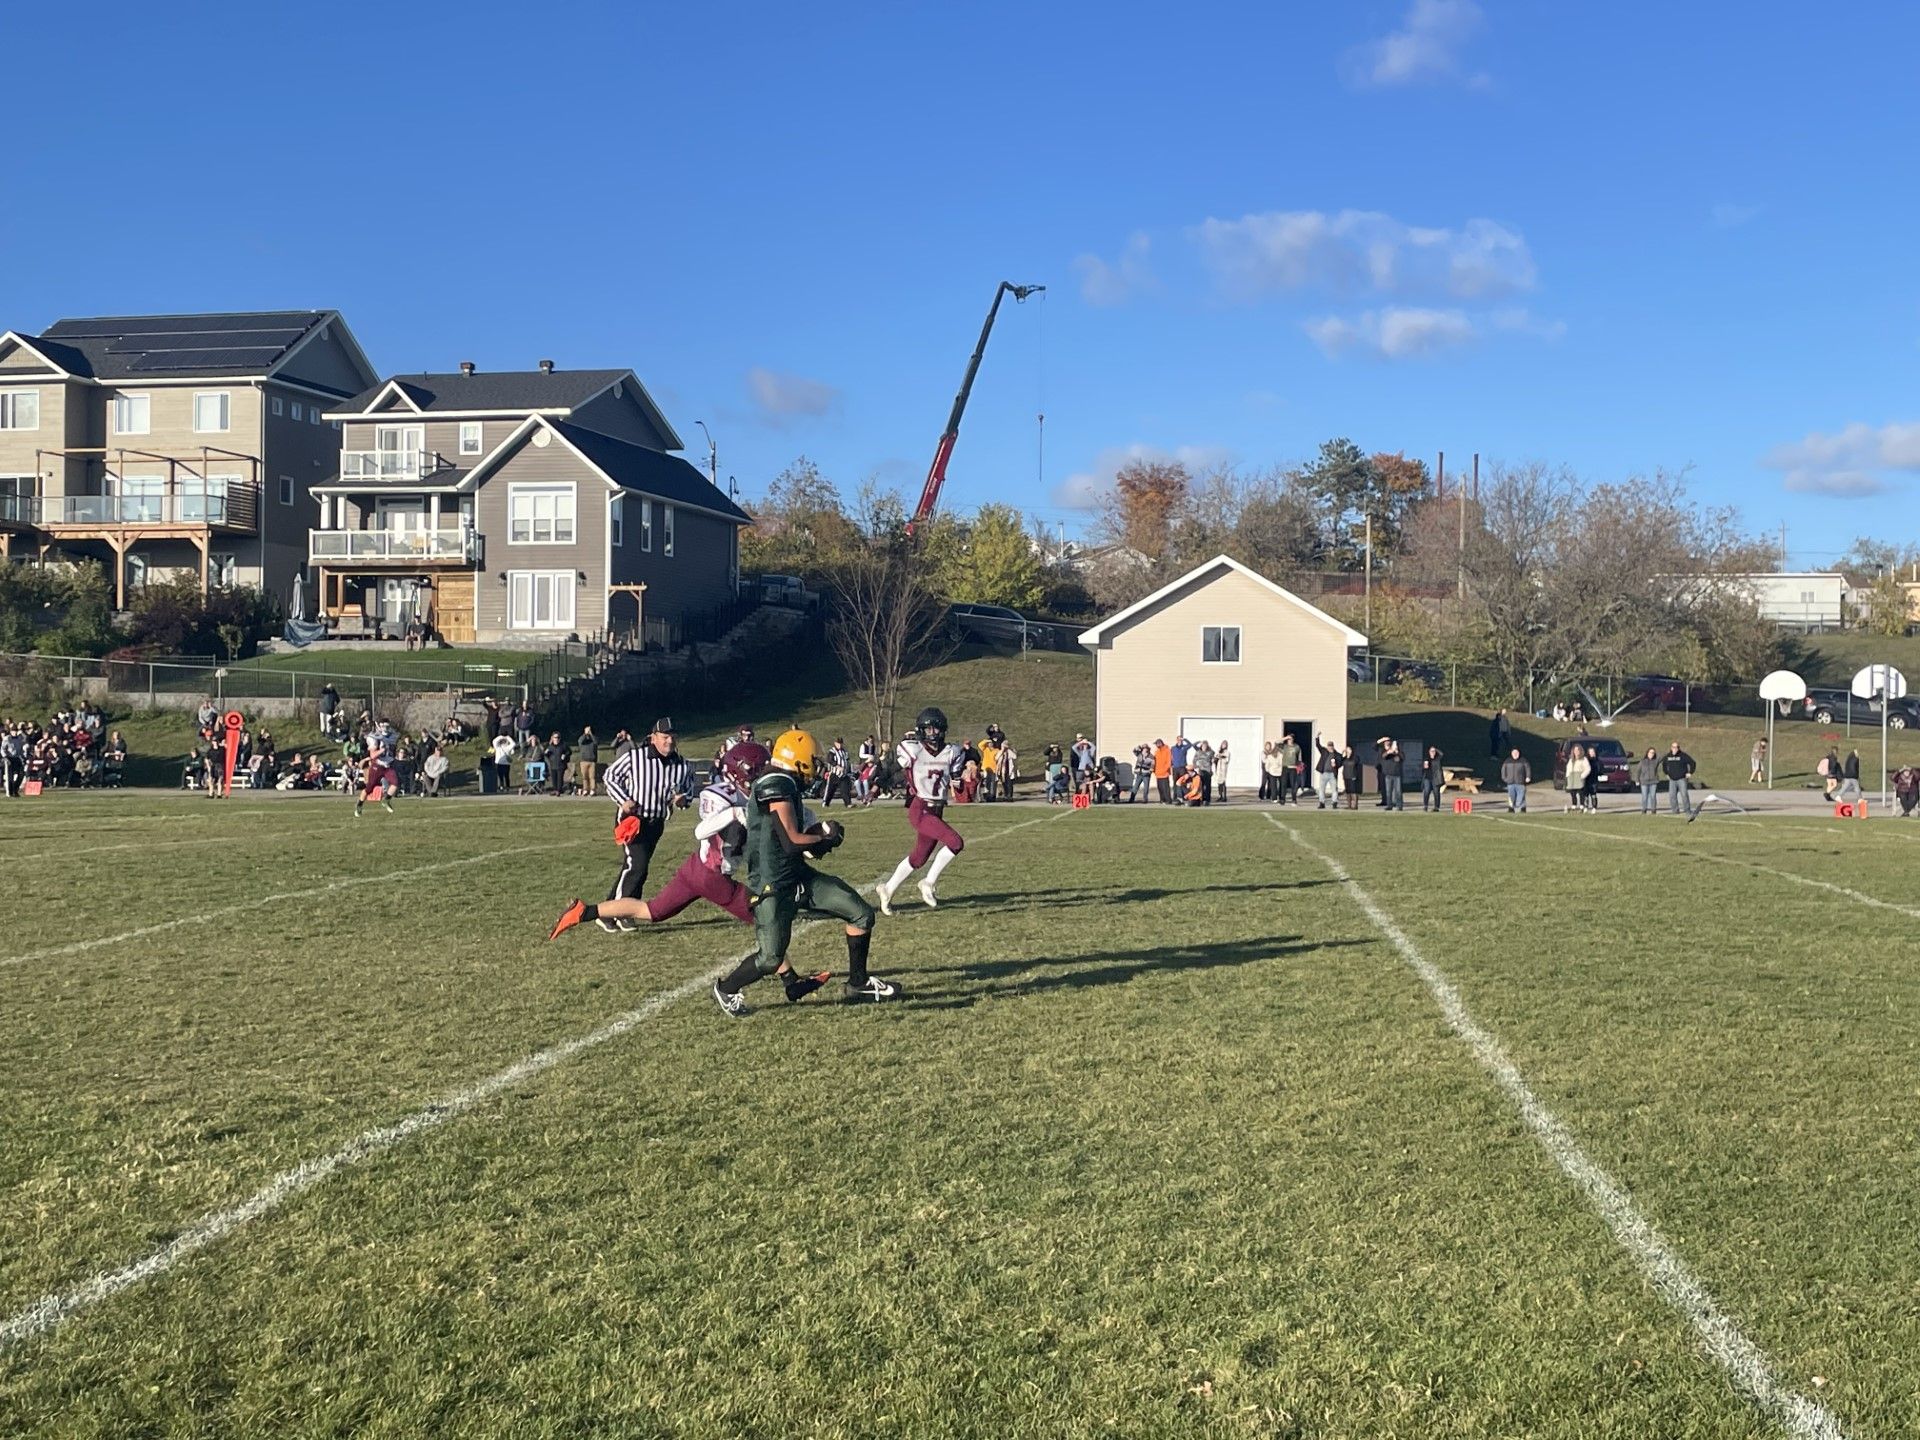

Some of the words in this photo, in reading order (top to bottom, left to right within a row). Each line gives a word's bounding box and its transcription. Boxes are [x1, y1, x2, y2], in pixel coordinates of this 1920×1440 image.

[928, 770, 943, 797] 7
[1075, 795, 1088, 808] 20
[1458, 800, 1470, 814] 10
[1840, 804, 1853, 817] G
